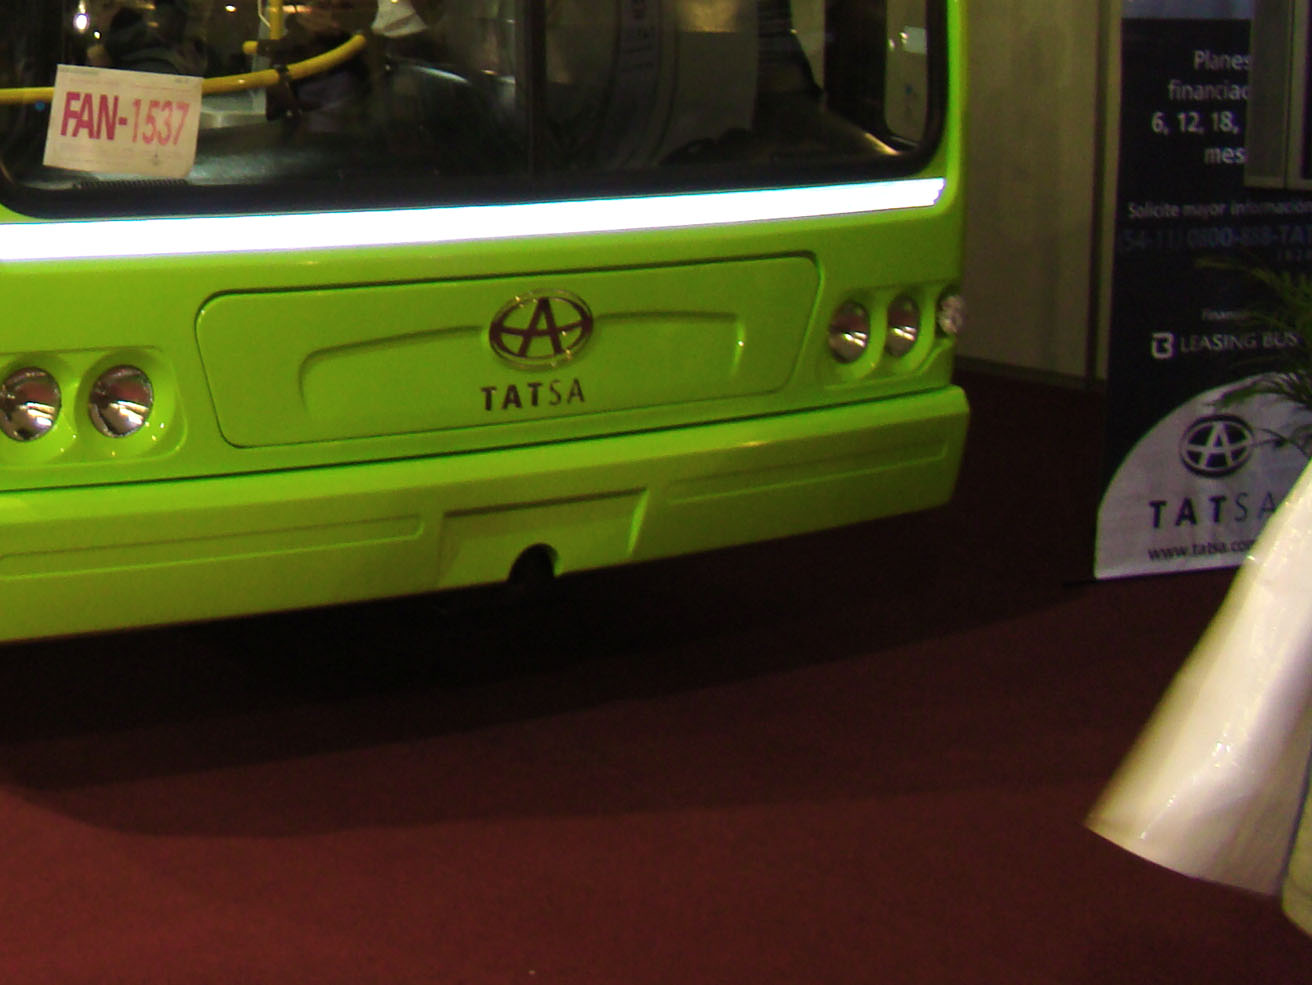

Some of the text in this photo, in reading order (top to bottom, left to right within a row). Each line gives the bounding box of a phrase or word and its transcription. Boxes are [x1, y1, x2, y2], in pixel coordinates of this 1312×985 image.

[60, 91, 190, 146] FAN-1537
[1151, 111, 1169, 135] 6,
[481, 378, 585, 411] TATSA
[1148, 492, 1276, 529] TATSA
